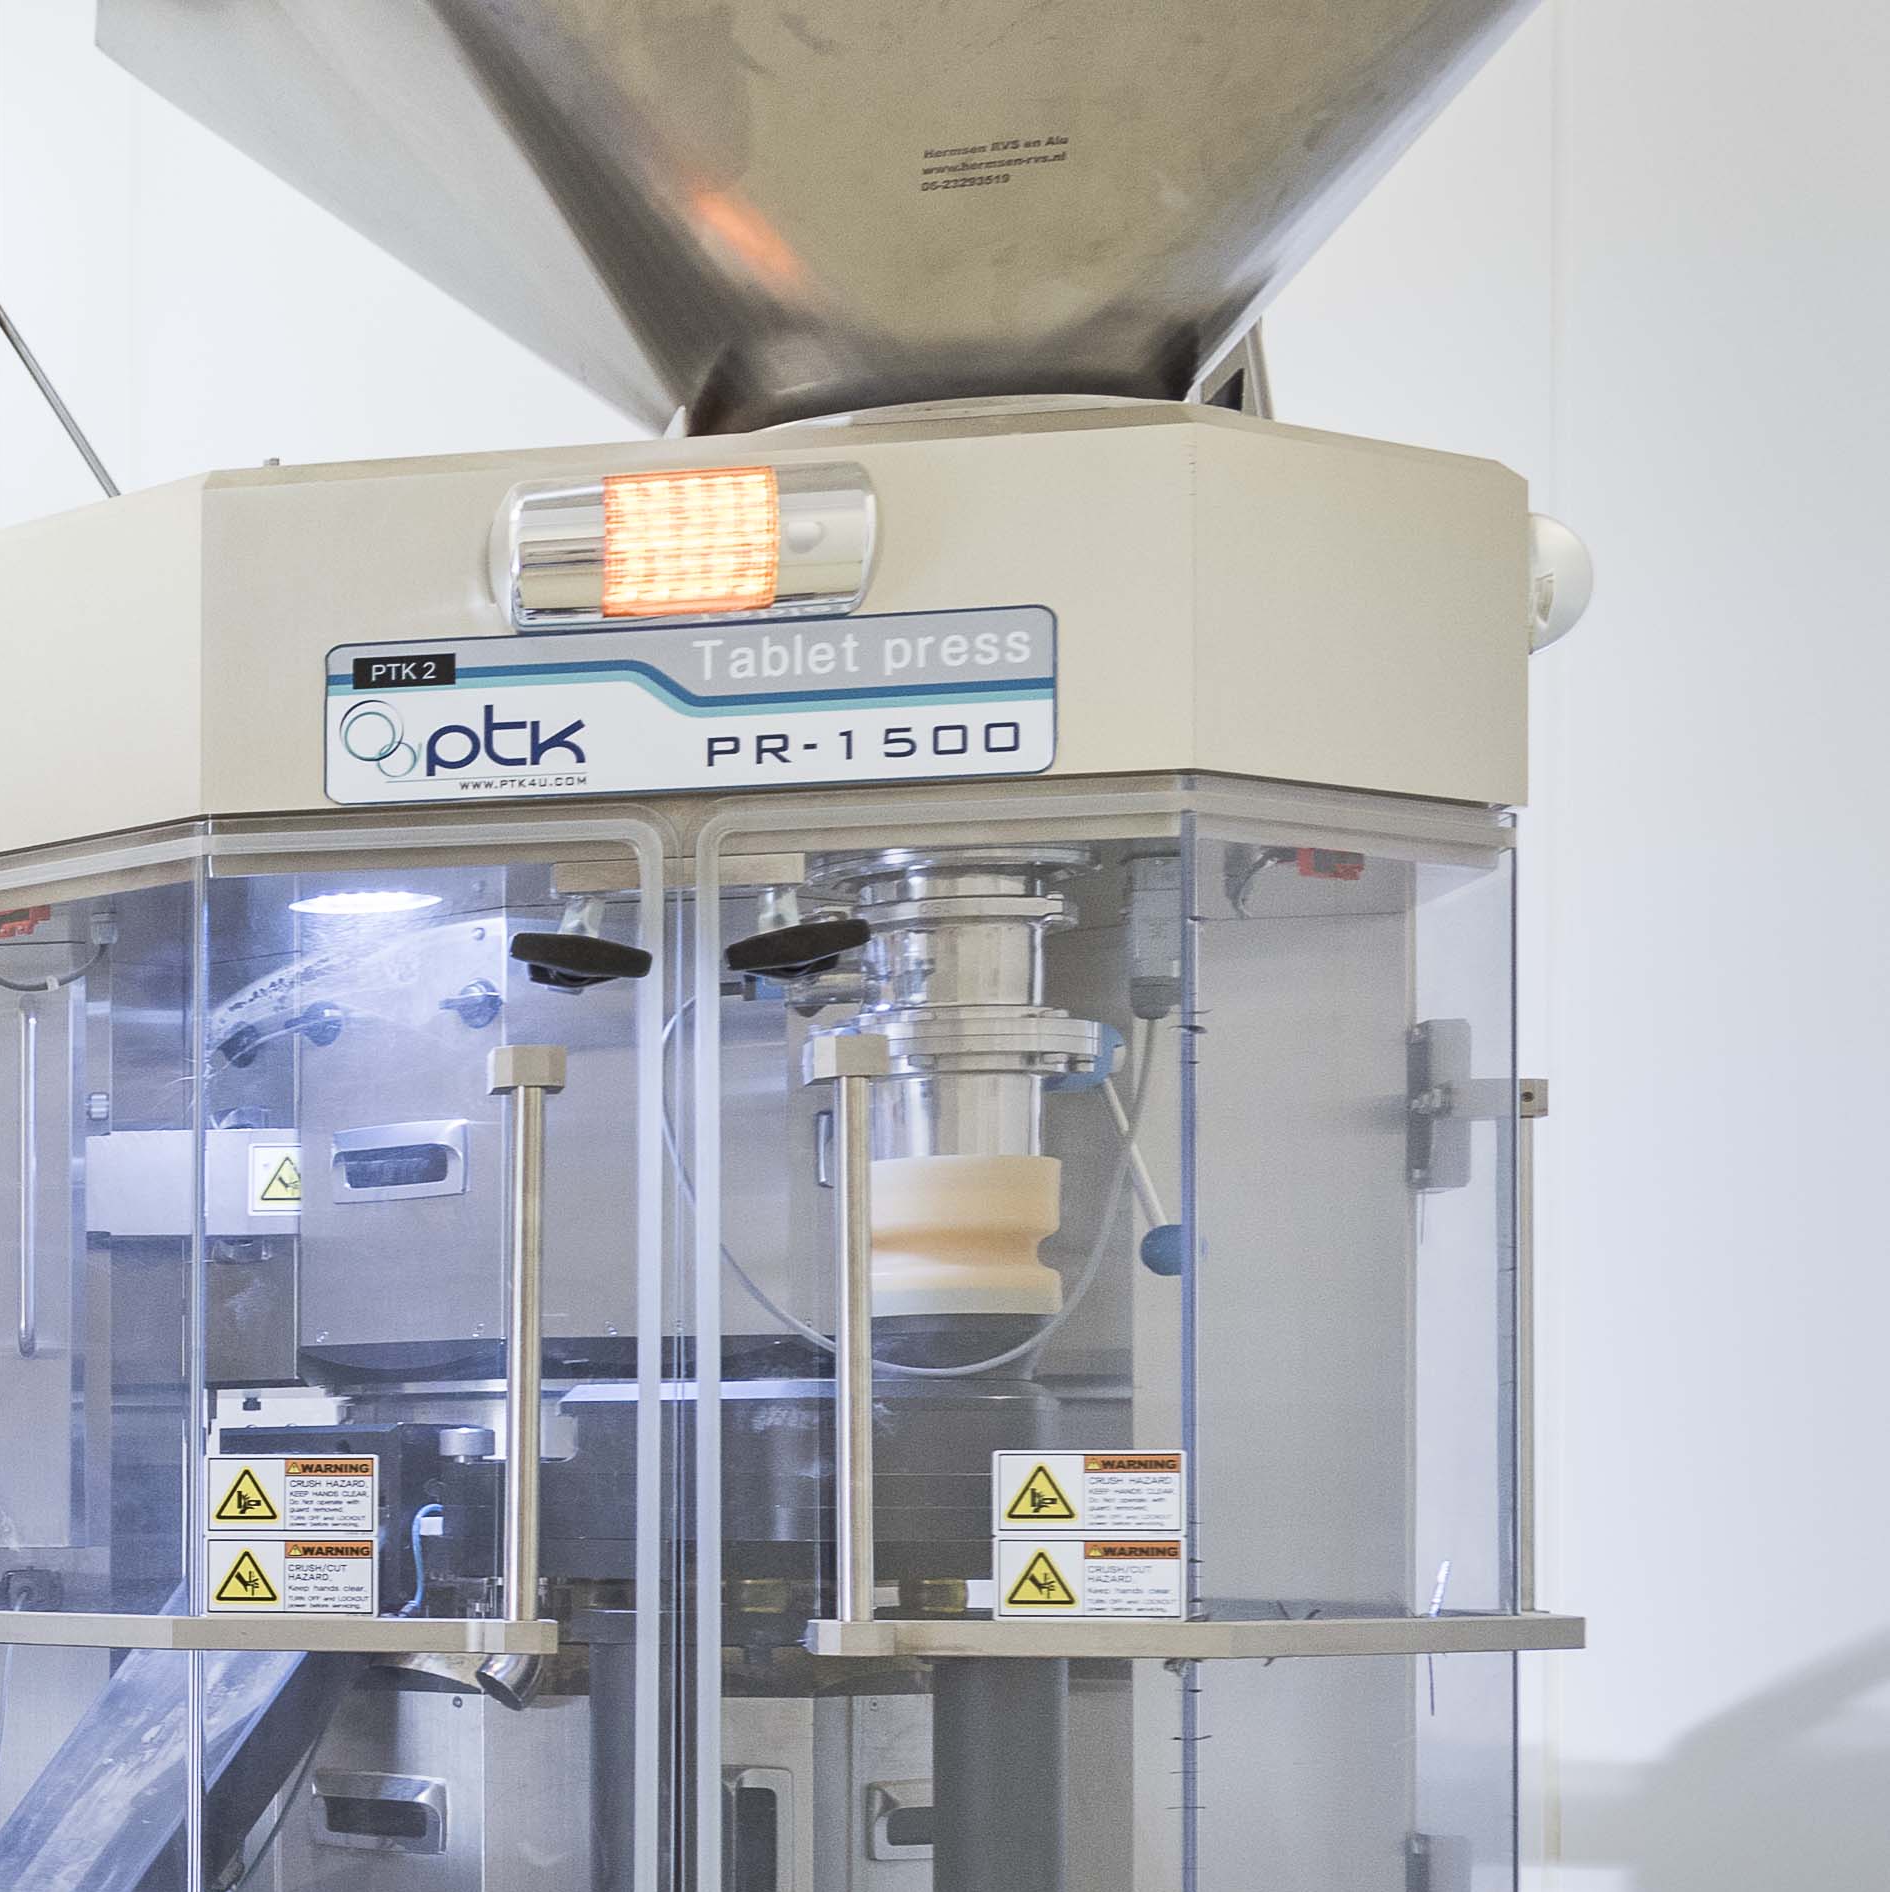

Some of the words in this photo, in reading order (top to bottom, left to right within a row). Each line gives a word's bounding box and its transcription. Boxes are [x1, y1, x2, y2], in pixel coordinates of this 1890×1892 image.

[1023, 140, 1041, 148] en
[692, 633, 860, 681] Tablet
[884, 630, 1031, 676] press
[371, 662, 417, 681] PTK
[422, 662, 436, 679] 2
[426, 704, 586, 776] ptk
[460, 776, 587, 790] WWW.PTK4U.COM
[301, 1464, 369, 1473] WARNING
[1101, 1460, 1177, 1469] WARNING
[302, 1546, 370, 1556] WARNING
[1102, 1547, 1178, 1556] WARNING
[288, 1564, 348, 1572] CRUSH/CUT
